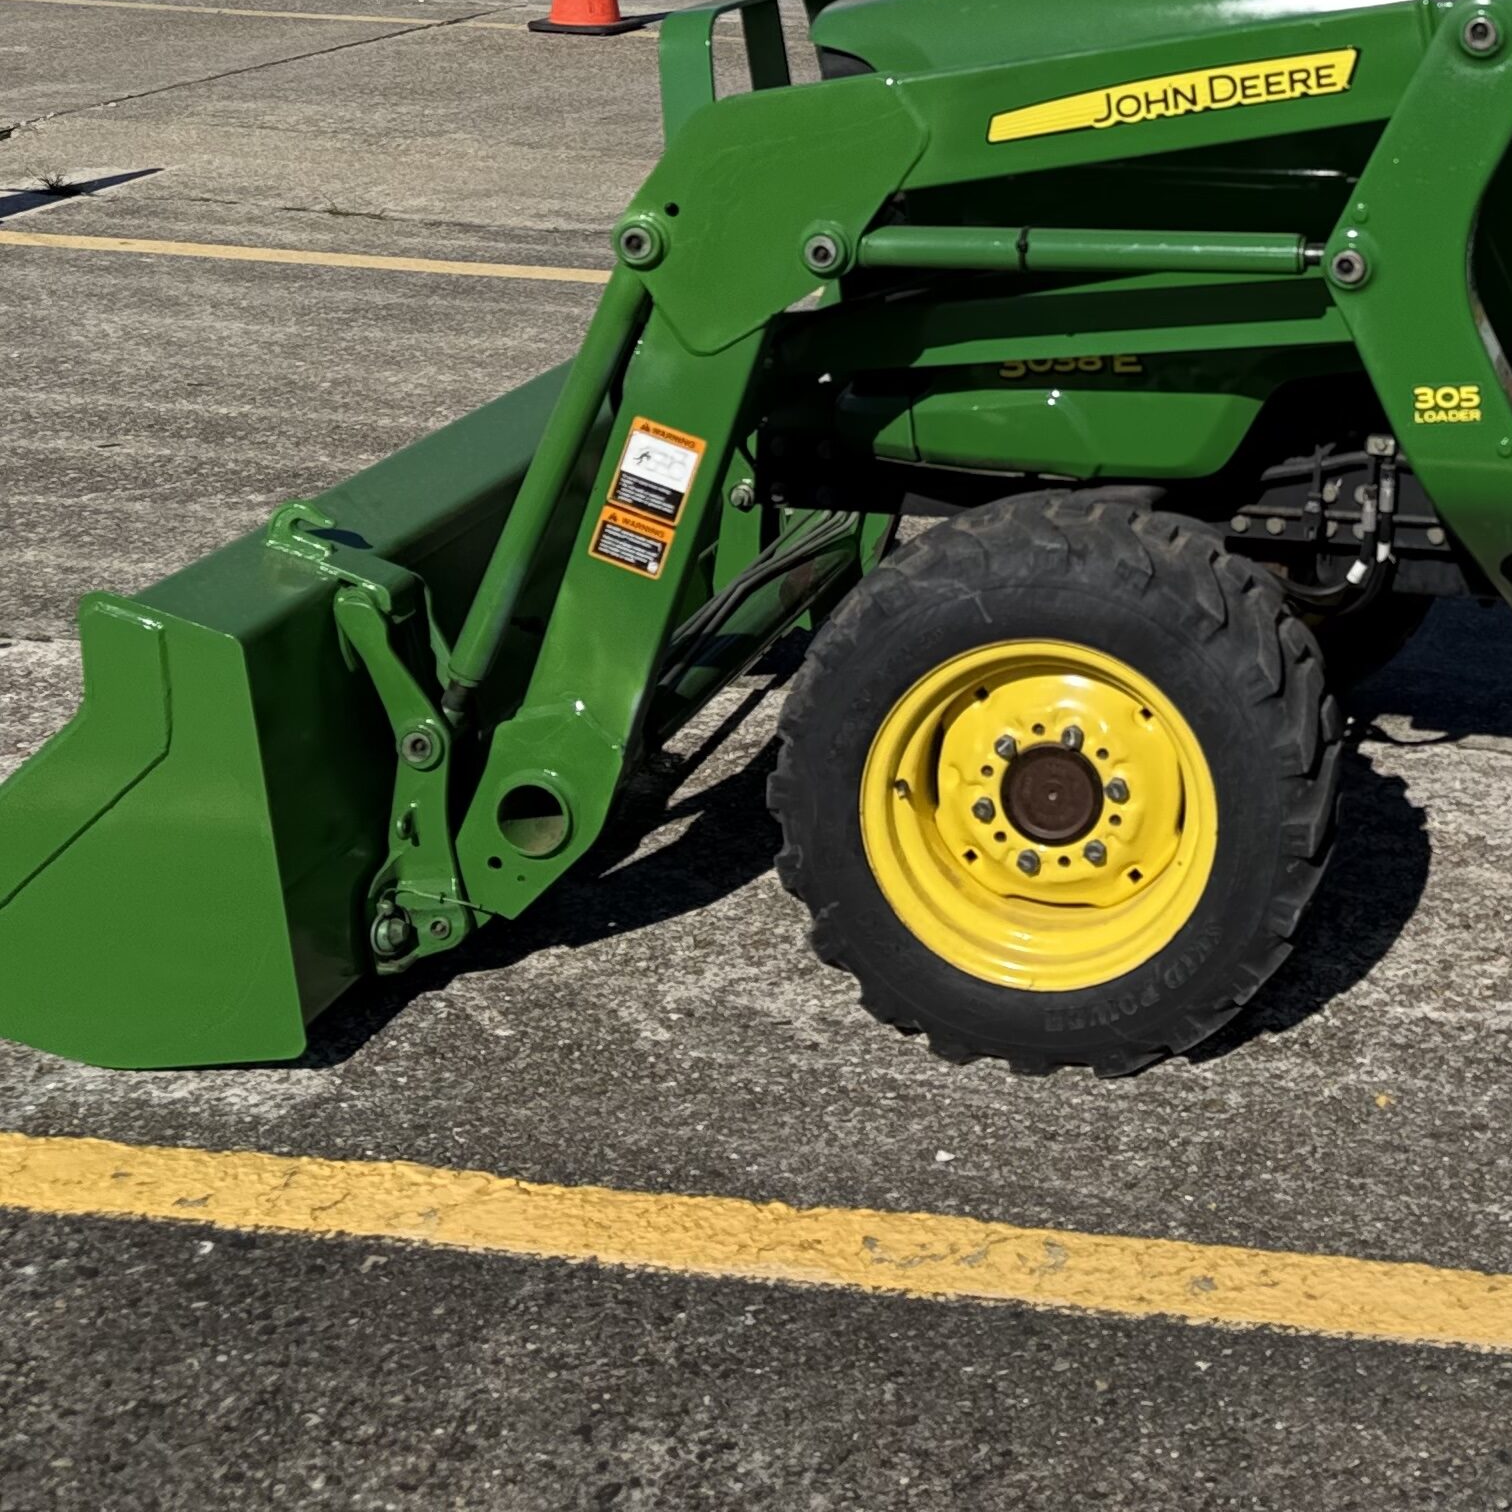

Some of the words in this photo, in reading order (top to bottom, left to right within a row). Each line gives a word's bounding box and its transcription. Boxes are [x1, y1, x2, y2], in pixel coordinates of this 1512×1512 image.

[1093, 84, 1198, 123] JOHN
[1207, 64, 1337, 104] DEERE
[1414, 385, 1481, 409] 305
[1414, 409, 1482, 424] LOADER
[651, 426, 697, 449] WARNING
[621, 516, 666, 539] WARNING
